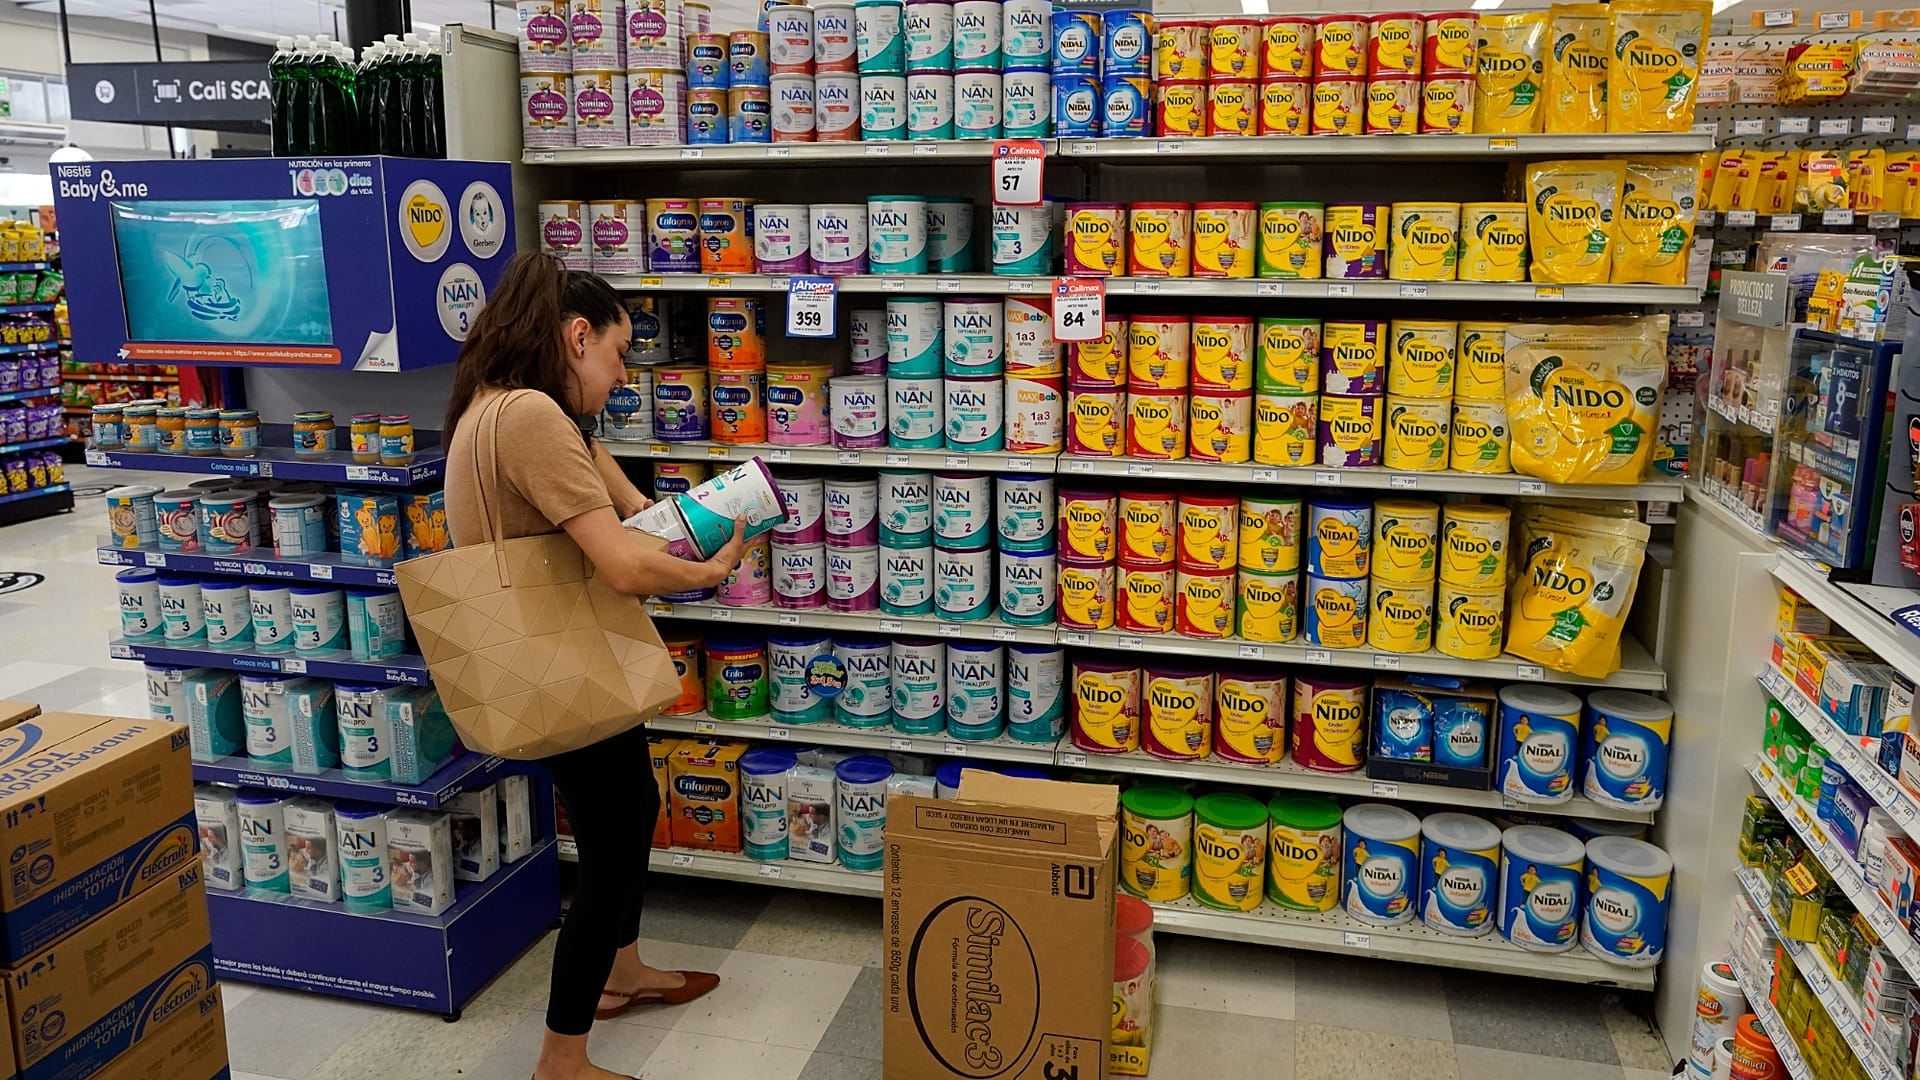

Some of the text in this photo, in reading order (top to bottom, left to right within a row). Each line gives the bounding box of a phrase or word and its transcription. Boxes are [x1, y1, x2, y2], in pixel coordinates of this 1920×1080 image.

[818, 19, 847, 30] NAN
[1011, 14, 1040, 26] NAN
[1325, 32, 1352, 43] NIDO
[1440, 29, 1470, 40] NIDO
[1058, 39, 1085, 50] NIDAL
[1629, 50, 1678, 68] NIDO
[189, 80, 271, 100] Cali SCA
[781, 90, 812, 101] NAN
[962, 88, 993, 99] NAN
[1427, 90, 1455, 101] NIDO
[1107, 102, 1132, 113] NIDAL
[349, 174, 373, 188] días
[1002, 175, 1020, 191] 57
[410, 207, 442, 225] NIDO
[872, 212, 907, 226] NAN
[1550, 204, 1597, 222] NIDO
[760, 218, 789, 230] NAN
[1075, 221, 1110, 234] NIDO
[1263, 221, 1298, 234] NIDO
[1411, 232, 1450, 245] NIDO
[1013, 241, 1022, 255] 3
[443, 284, 478, 303] NAN
[1729, 279, 1774, 300] PRODUCTOS DE
[1737, 300, 1763, 318] BELLEZA
[459, 312, 469, 332] 3
[795, 311, 821, 326] 359
[954, 314, 992, 328] NAN
[1063, 311, 1085, 327] 84
[1266, 337, 1302, 349] NIDO
[1406, 349, 1444, 362] NIDO
[844, 395, 876, 405] NAN
[895, 391, 932, 404] NAN
[1553, 385, 1624, 408] NIDO
[1077, 404, 1110, 416] NIDO
[1334, 421, 1372, 433] NIDO
[892, 484, 928, 498] NAN
[1004, 490, 1041, 504] NAN
[1070, 512, 1102, 523] NIDO
[1185, 518, 1218, 529] NIDO
[1319, 530, 1356, 541] NIDAL
[1390, 535, 1428, 549] NIDO
[782, 556, 813, 568] NAN
[1006, 567, 1042, 579] NAN
[1036, 594, 1044, 606] 3
[1188, 588, 1221, 600] NIDO
[1459, 613, 1496, 627] NIDO
[847, 656, 890, 671] NAN
[952, 663, 996, 679] NAN
[932, 695, 940, 707] 2
[1080, 686, 1122, 703] NIDO
[1152, 690, 1195, 710] NIDO
[990, 696, 998, 710] 3
[1317, 704, 1360, 721] NIDO
[1450, 735, 1481, 745] NIDAL
[1526, 745, 1563, 758] NIDAL
[1603, 748, 1642, 763] NIDAL
[841, 793, 885, 811] NAN
[778, 817, 787, 831] 3
[1273, 838, 1319, 861] NIDO
[141, 836, 188, 881] Electrolit
[83, 866, 125, 900] TOTAL!
[1051, 863, 1060, 896] Abbott
[1364, 869, 1400, 884] NIDAL
[1534, 895, 1570, 908] NIDAL
[1595, 899, 1633, 918] NIDAL
[889, 844, 902, 1013] Contenido 12 envases de 850g cada uno
[951, 937, 960, 1034] Fórmula de continuación
[152, 972, 201, 1023] Electrolit
[1110, 1053, 1143, 1067] erlo,
